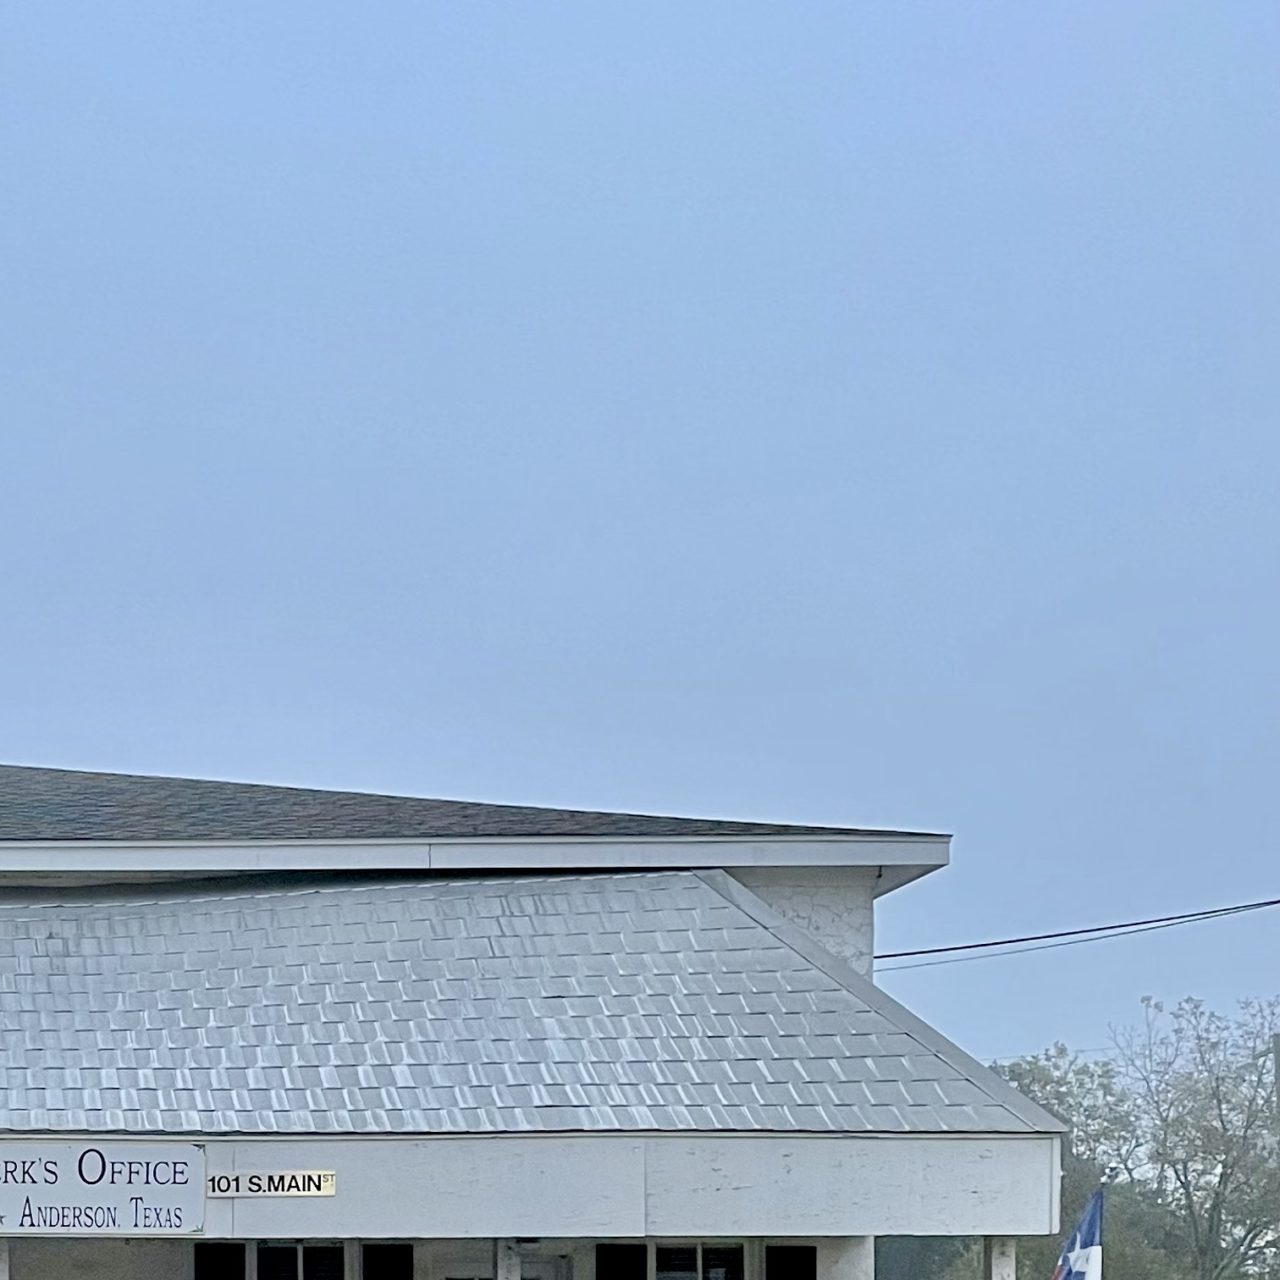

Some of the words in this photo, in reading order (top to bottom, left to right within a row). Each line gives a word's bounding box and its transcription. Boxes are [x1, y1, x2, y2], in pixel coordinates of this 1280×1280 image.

[77, 1148, 189, 1185] OFFICE
[208, 1175, 240, 1193] 101
[129, 1196, 183, 1229] TEXAS
